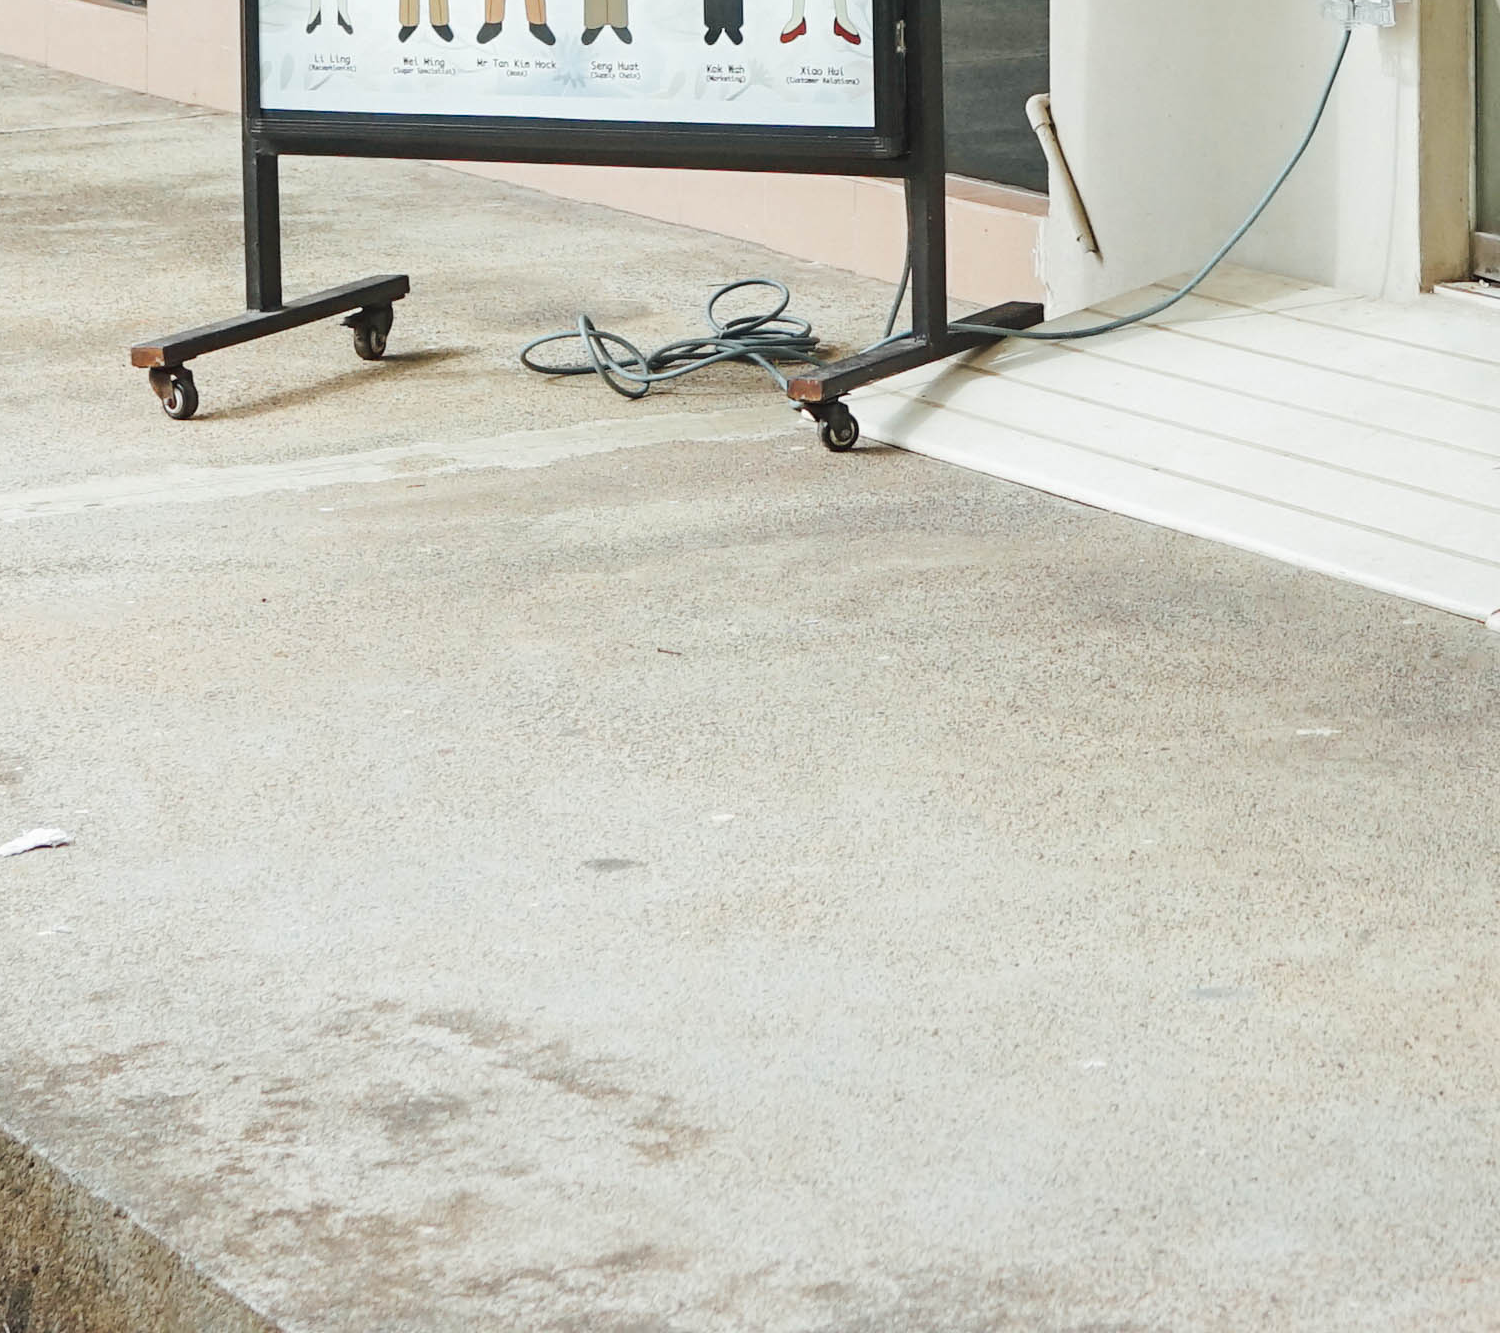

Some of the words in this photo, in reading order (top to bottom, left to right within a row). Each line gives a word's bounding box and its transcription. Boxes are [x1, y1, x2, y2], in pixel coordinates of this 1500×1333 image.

[492, 59, 509, 68] Tan
[535, 60, 556, 69] Hock
[591, 60, 613, 72] Seng
[617, 61, 639, 70] Huat
[800, 66, 823, 75] Xiao
